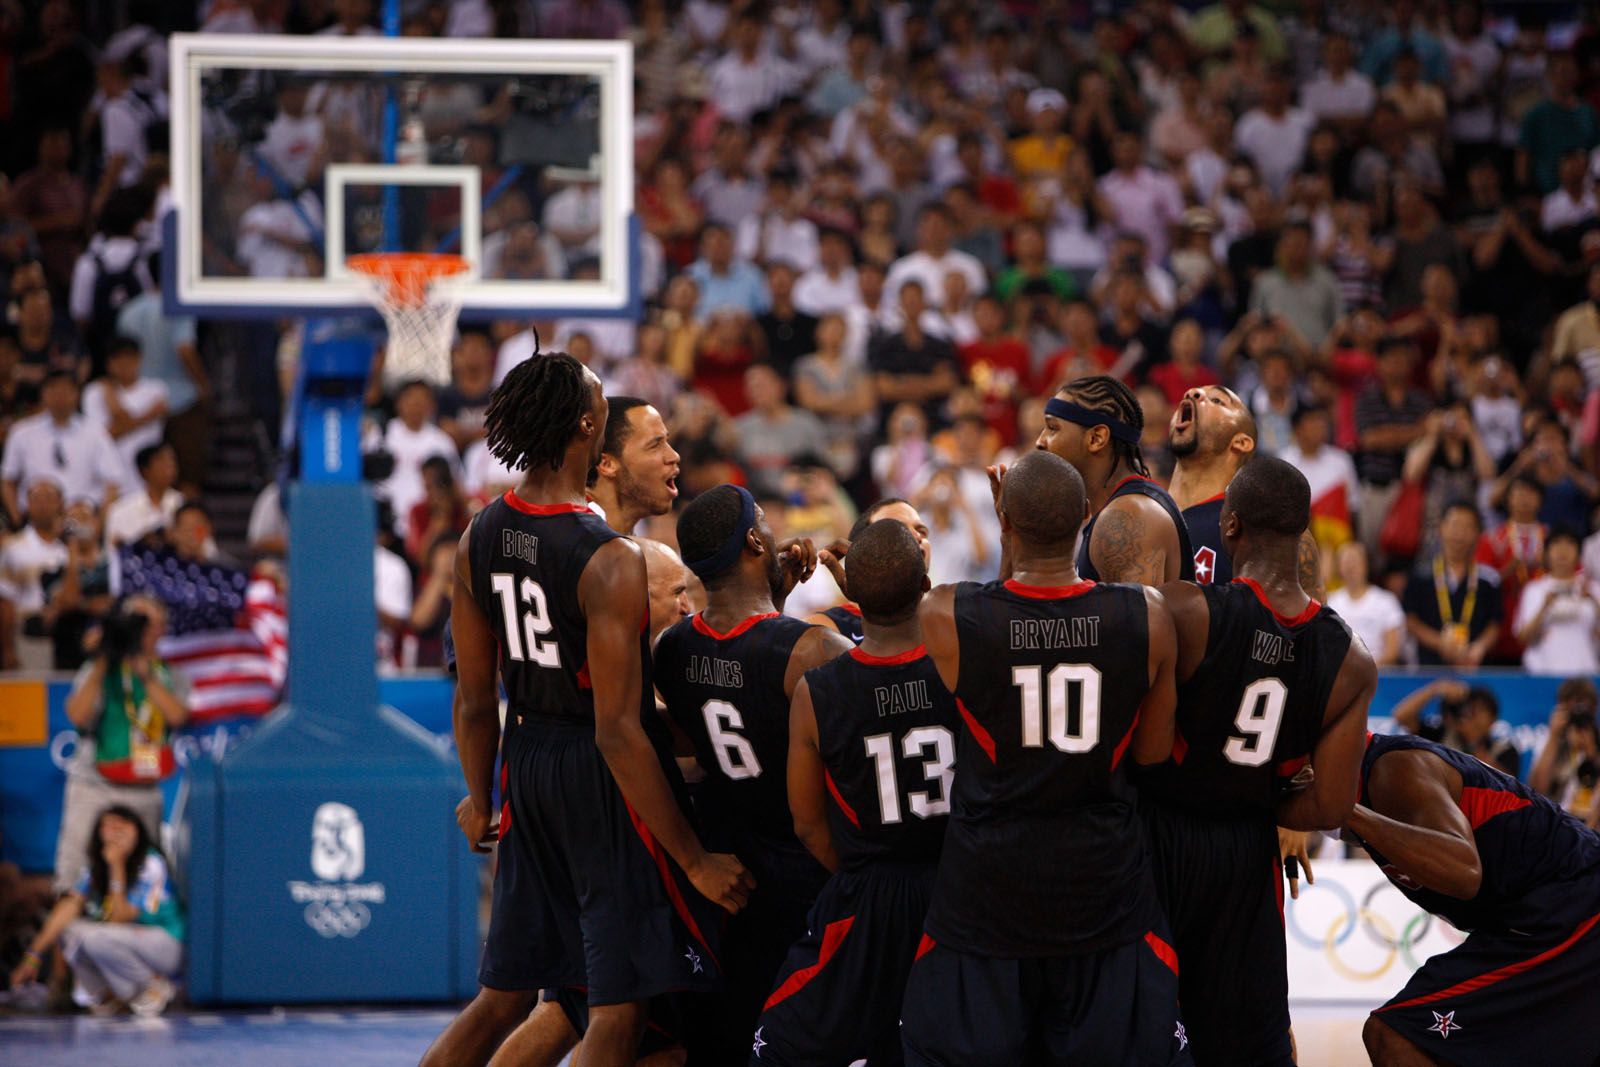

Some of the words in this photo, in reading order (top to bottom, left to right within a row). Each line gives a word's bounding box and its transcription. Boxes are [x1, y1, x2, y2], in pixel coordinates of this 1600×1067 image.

[503, 528, 538, 565] BOSH
[490, 573, 562, 668] 12
[1010, 616, 1100, 650] BRYANT
[1251, 629, 1295, 665] WAE
[701, 698, 763, 780] 6
[875, 680, 932, 717] PAUL
[1011, 663, 1102, 753] 10
[1222, 677, 1288, 767] 9
[863, 725, 957, 824] 13
